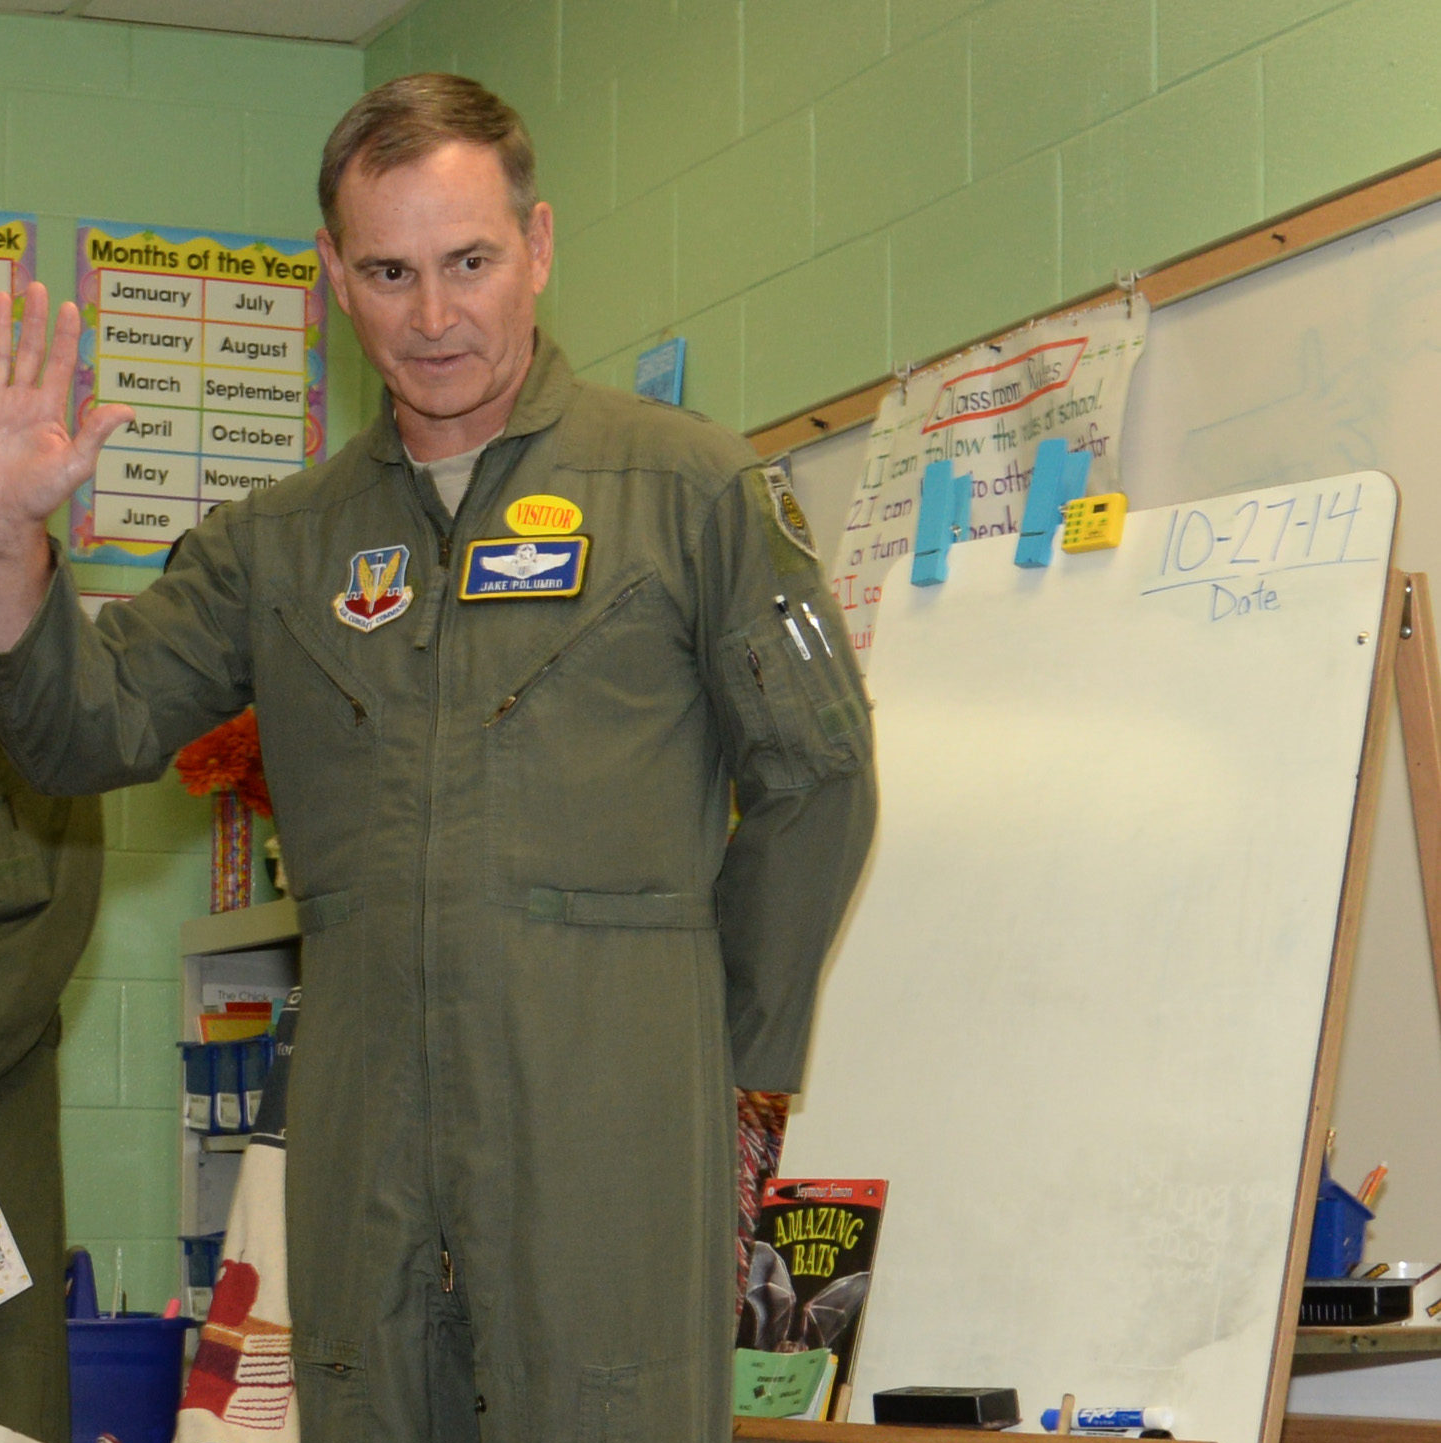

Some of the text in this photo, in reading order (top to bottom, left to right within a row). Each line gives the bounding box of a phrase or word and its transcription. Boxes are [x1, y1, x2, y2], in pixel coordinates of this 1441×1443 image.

[91, 239, 317, 282] Months of the Year
[110, 282, 191, 308] January
[235, 293, 275, 316] July
[105, 326, 194, 353] February
[219, 335, 289, 360] August
[117, 371, 182, 393] March
[205, 379, 302, 404] September
[934, 380, 1022, 421] Classroom
[126, 418, 173, 438] April
[211, 424, 295, 448] October
[124, 463, 170, 486] May
[203, 469, 279, 490] Novemb
[121, 508, 171, 528] June
[516, 502, 575, 530] VISITOR
[1160, 482, 1364, 576] 10-27-14
[480, 579, 508, 592] JAKE
[1211, 579, 1282, 623] Date
[774, 1207, 865, 1250] AMAZING
[792, 1243, 839, 1278] BATS
